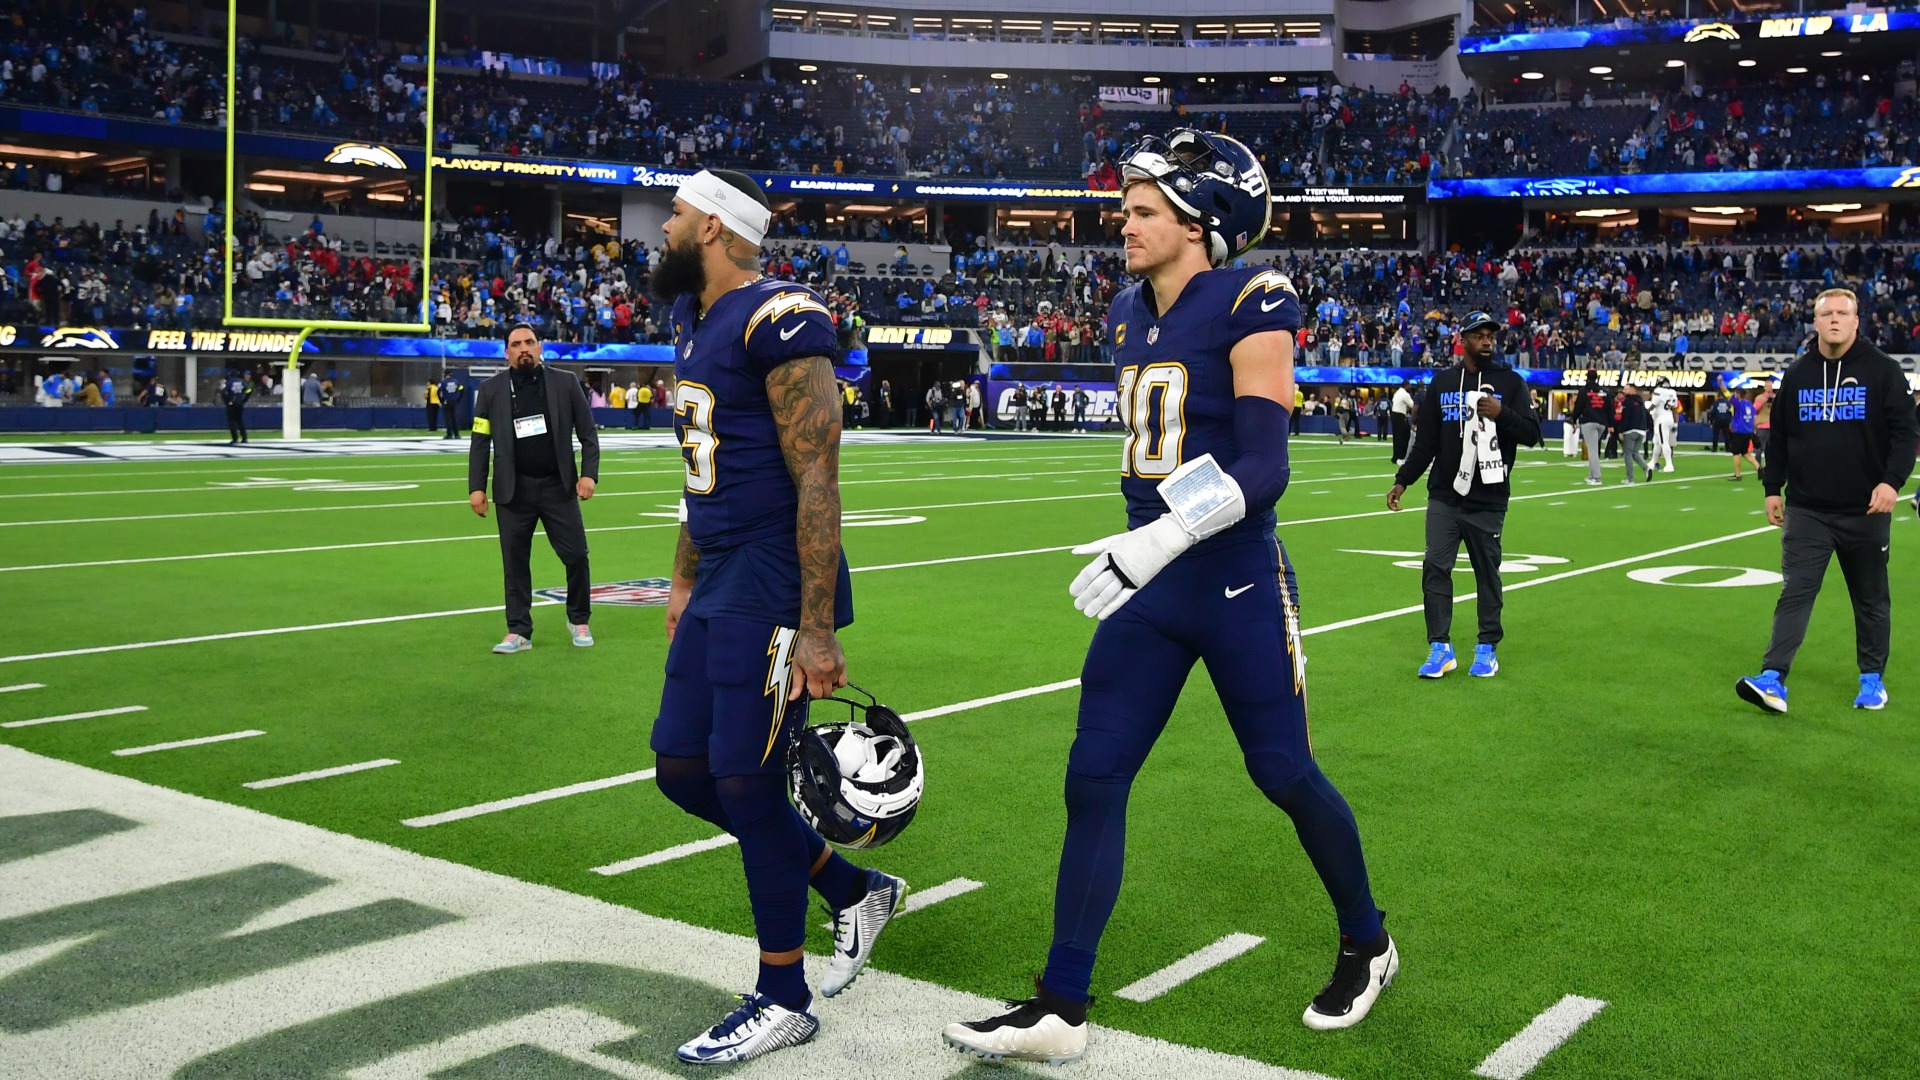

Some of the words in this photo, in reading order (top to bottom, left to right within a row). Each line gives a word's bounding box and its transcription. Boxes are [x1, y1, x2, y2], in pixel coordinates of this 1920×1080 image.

[1759, 17, 1804, 38] BOLT
[1850, 13, 1889, 33] LA
[431, 155, 502, 172] PLAYOFF
[503, 162, 577, 178] PRIORITY
[578, 167, 617, 180] WITH
[654, 172, 693, 187] seas
[790, 180, 836, 190] LEARN
[836, 182, 875, 192] MORE
[915, 186, 1122, 198] CHARGERS.COM/SEASON-TICKE
[1286, 195, 1301, 203] AND
[1302, 195, 1325, 203] THANK
[1326, 195, 1341, 203] YOU
[1342, 195, 1354, 203] FOR
[1355, 195, 1374, 203] YOUR
[1375, 195, 1404, 203] SUPPORT
[1310, 188, 1327, 196] TEXT
[1327, 188, 1349, 196] WHILE
[147, 329, 187, 350] FEEL
[191, 331, 227, 351] THE
[1561, 369, 1589, 386] SEE
[1798, 387, 1867, 404] INSPIRE
[1118, 361, 1188, 479] 10
[1799, 404, 1866, 421] CHANGE
